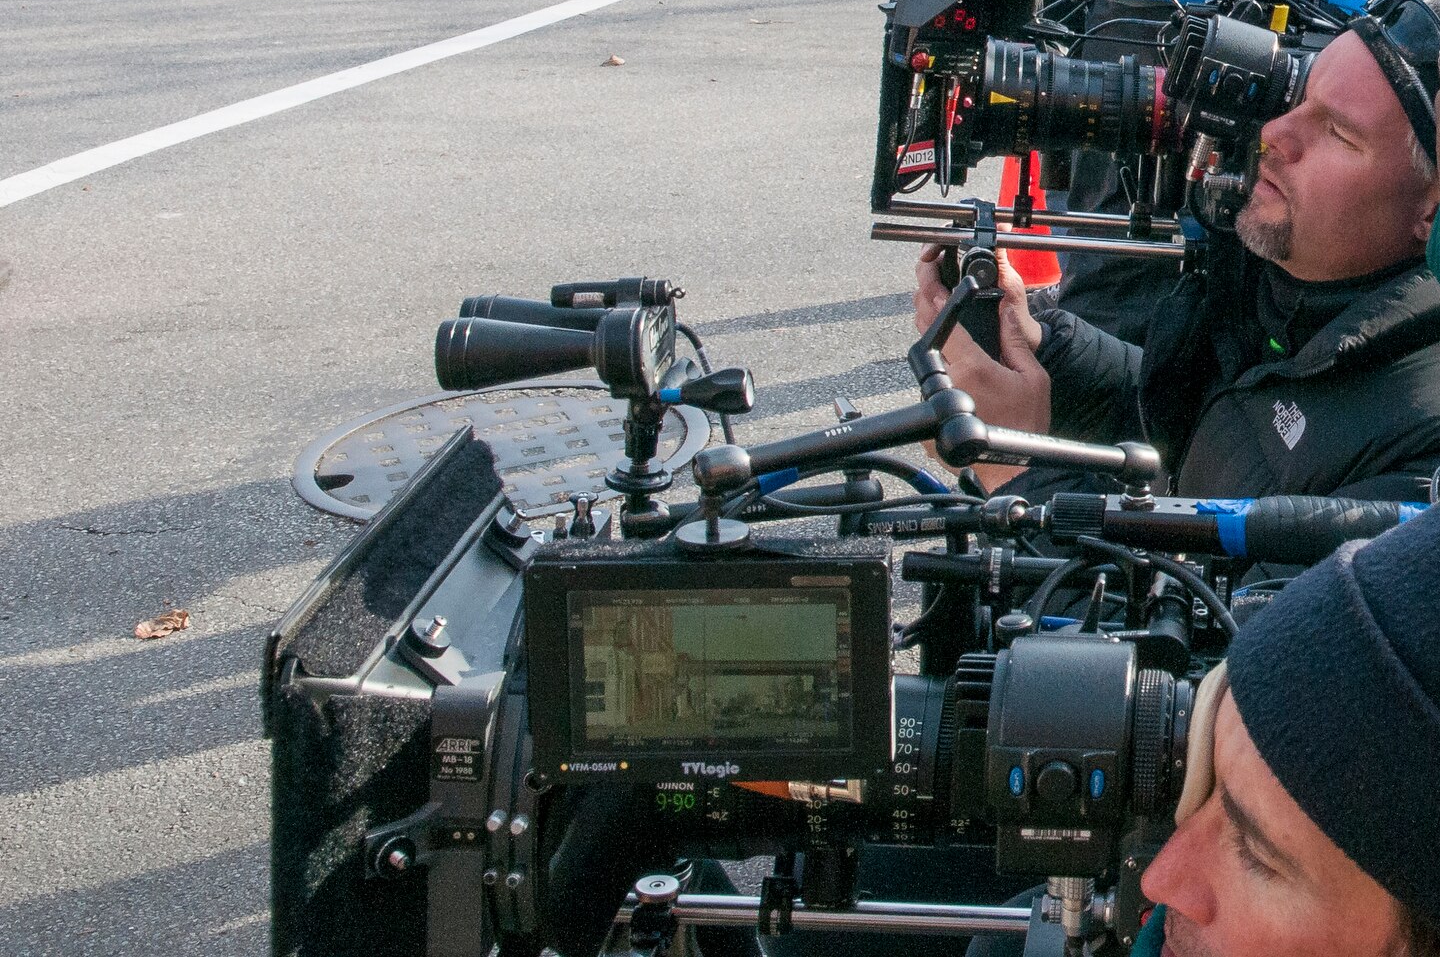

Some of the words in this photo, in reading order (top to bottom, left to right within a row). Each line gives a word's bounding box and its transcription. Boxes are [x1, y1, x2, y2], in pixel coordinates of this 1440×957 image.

[1272, 399, 1296, 430] NORTH
[1288, 401, 1303, 422] THE
[1272, 415, 1289, 438] FACE
[867, 521, 894, 534] ARMS
[896, 519, 918, 532] CINE
[899, 717, 915, 728] 90
[898, 728, 914, 738] 80
[435, 738, 472, 753] ARRI
[896, 743, 912, 754] 70
[681, 761, 740, 778] TVLogic
[894, 763, 910, 774] 60
[656, 782, 694, 791] UJINON
[893, 785, 909, 796] 50
[806, 814, 822, 824] 20
[892, 810, 908, 819] 40
